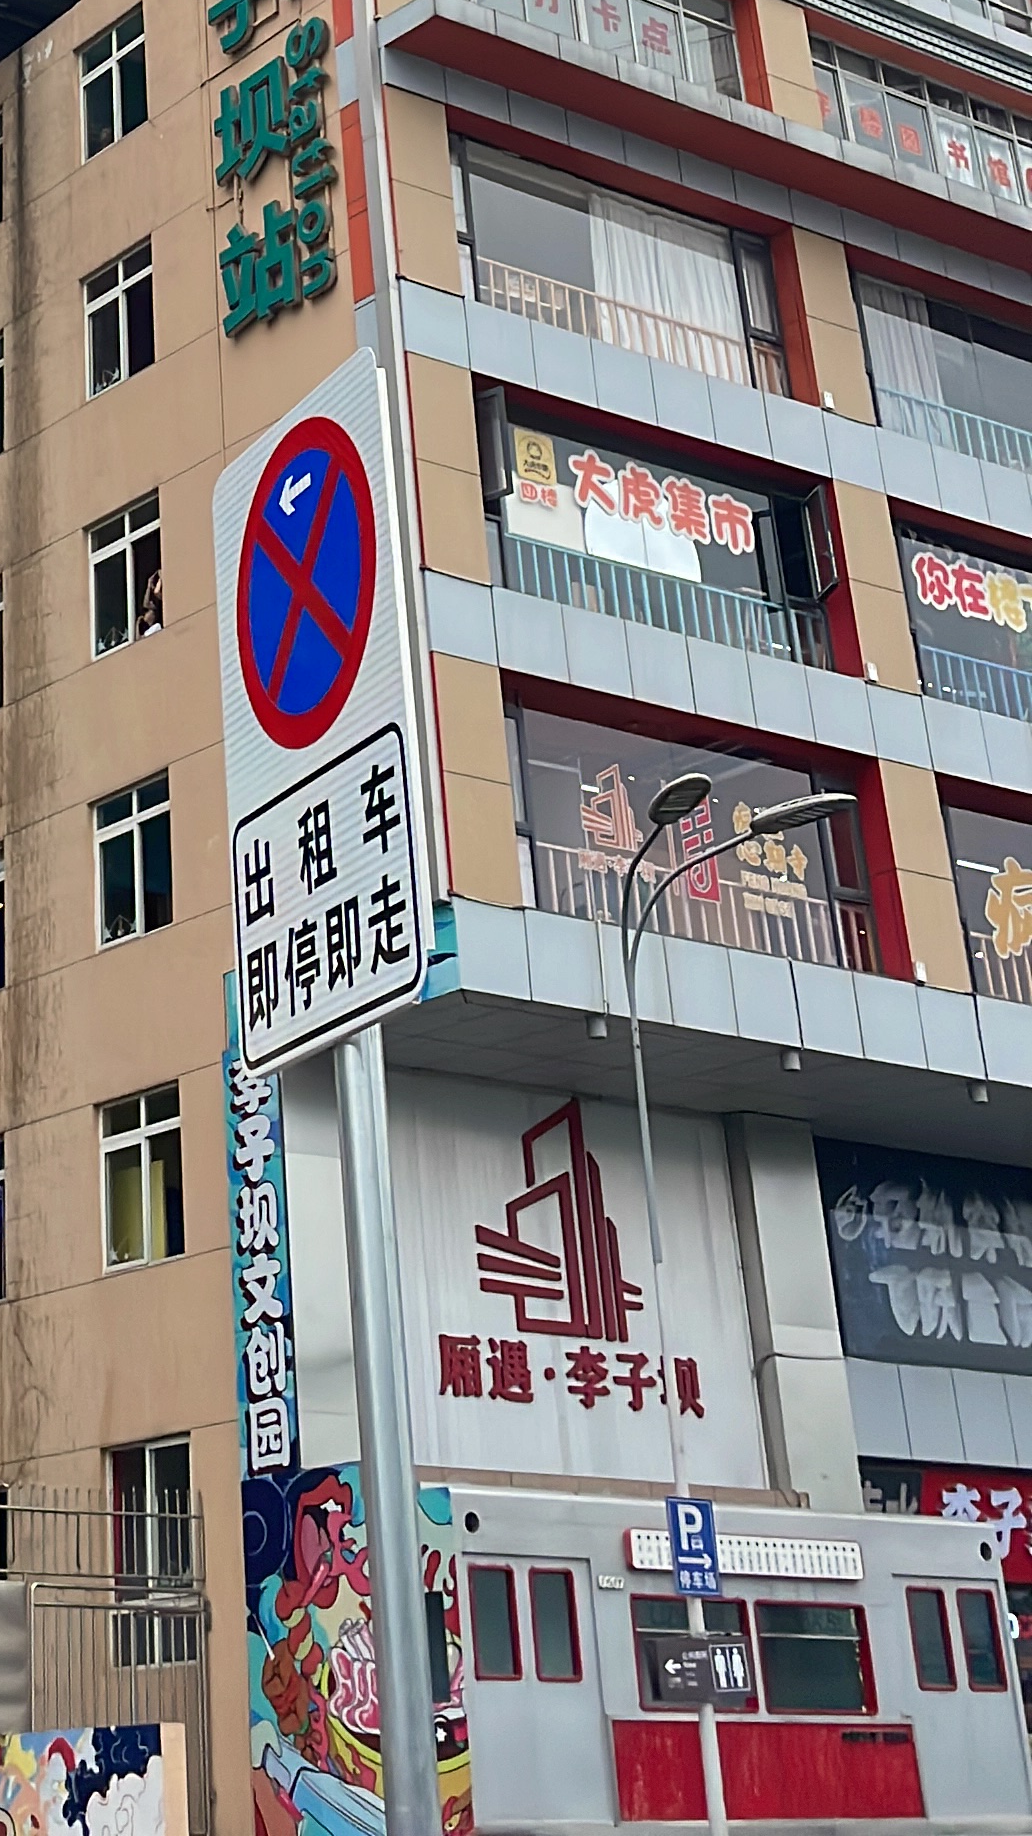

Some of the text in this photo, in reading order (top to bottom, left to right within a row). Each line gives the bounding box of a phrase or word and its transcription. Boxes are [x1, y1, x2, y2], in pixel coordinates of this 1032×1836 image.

[285, 16, 337, 300] Station
[570, 450, 755, 554] 大虎集市
[913, 553, 1032, 632] 你在楼
[244, 764, 401, 928] 出租车
[247, 873, 411, 1031] 即停即走
[231, 1059, 290, 1470] 李子坝文创园
[677, 1503, 703, 1551] P
